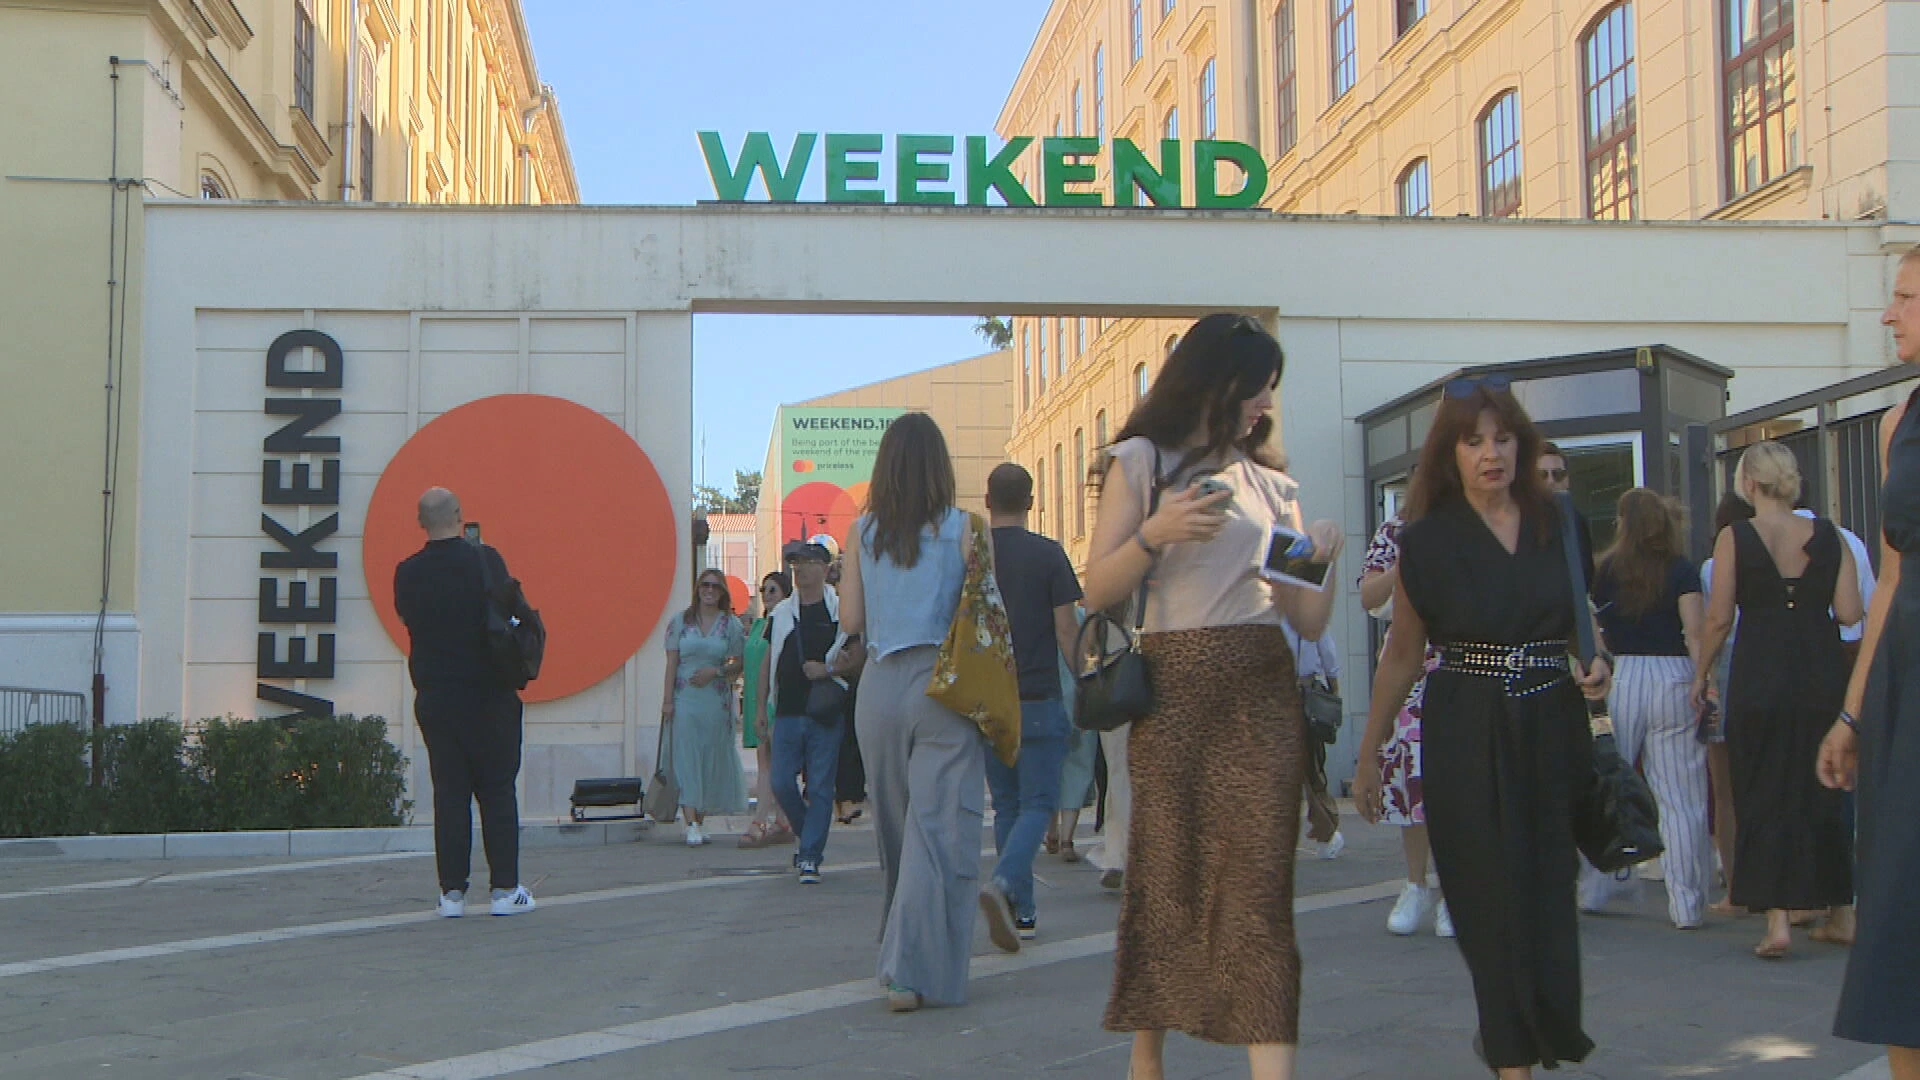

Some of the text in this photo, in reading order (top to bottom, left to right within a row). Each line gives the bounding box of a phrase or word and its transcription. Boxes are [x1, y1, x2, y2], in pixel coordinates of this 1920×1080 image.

[697, 131, 1268, 209] WEEKEND
[792, 438, 816, 447] Being
[818, 438, 838, 447] part
[840, 437, 850, 446] of
[852, 438, 867, 446] the
[792, 447, 831, 455] weekend
[833, 447, 843, 455] of
[845, 447, 860, 455] the
[817, 461, 854, 470] priceless
